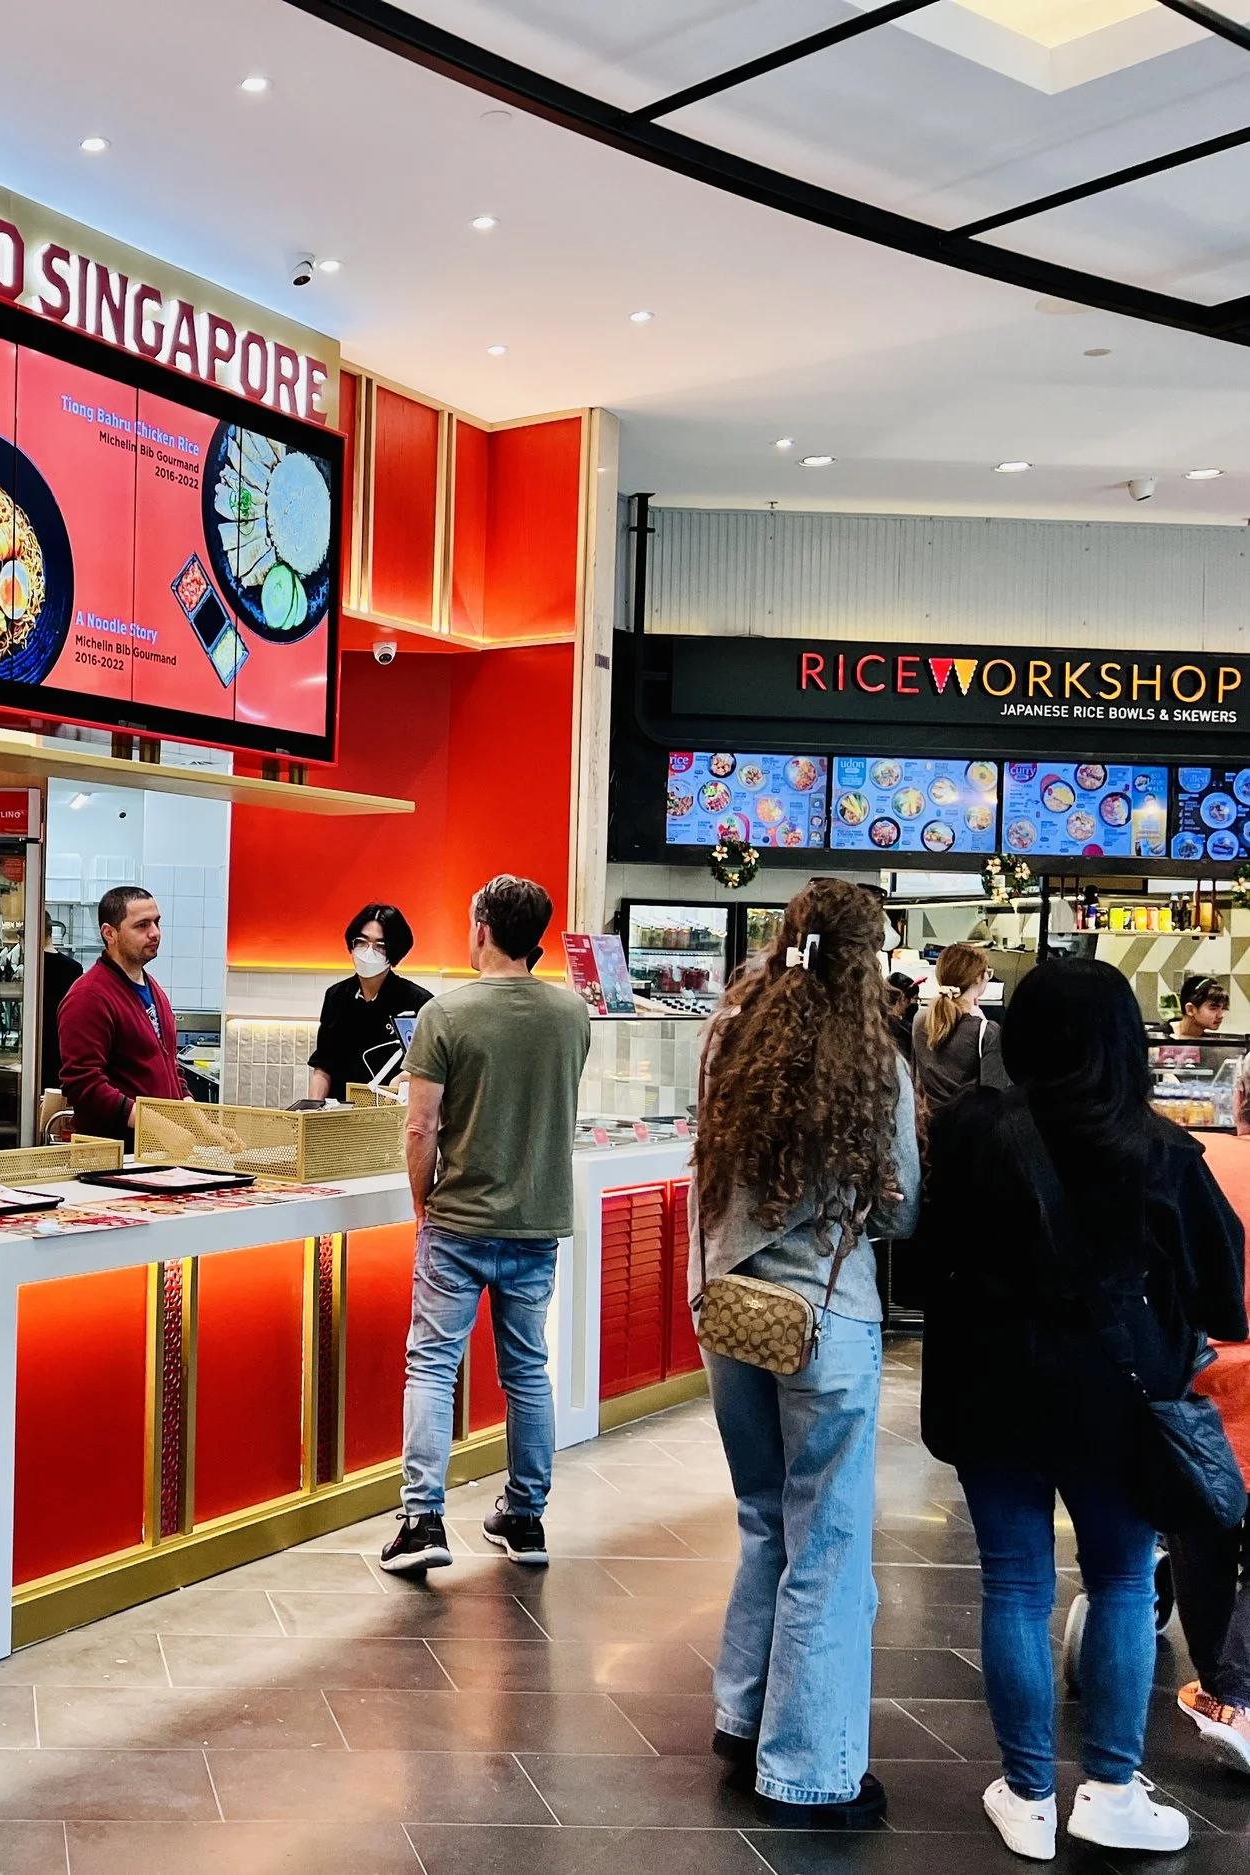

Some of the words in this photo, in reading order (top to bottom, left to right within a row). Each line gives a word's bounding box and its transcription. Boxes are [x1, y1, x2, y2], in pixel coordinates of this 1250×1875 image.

[35, 246, 330, 426] SINGAPORE
[61, 394, 94, 423] Tiong
[97, 407, 131, 432] Bahru
[134, 421, 175, 448] Chicken
[177, 436, 200, 456] Rice
[99, 431, 137, 452] Michelin
[140, 444, 154, 459] Bib
[156, 450, 199, 474] Gourmand
[155, 466, 199, 489] 2016-2022
[75, 611, 84, 626] A
[87, 612, 127, 636] Noodle
[129, 622, 158, 645] Story
[75, 634, 113, 653] Michelin
[116, 641, 131, 656] Bib
[132, 649, 177, 666] Gourmand
[75, 652, 124, 671] 2016-2022
[1000, 703, 1069, 719] JAPANESE
[1073, 705, 1104, 720] RICE
[1108, 706, 1156, 721] BOWLS
[1159, 708, 1169, 721] &
[1173, 708, 1238, 724] SKEWERS
[670, 754, 689, 765] rice
[840, 758, 865, 769] udon
[1010, 767, 1037, 778] curry
